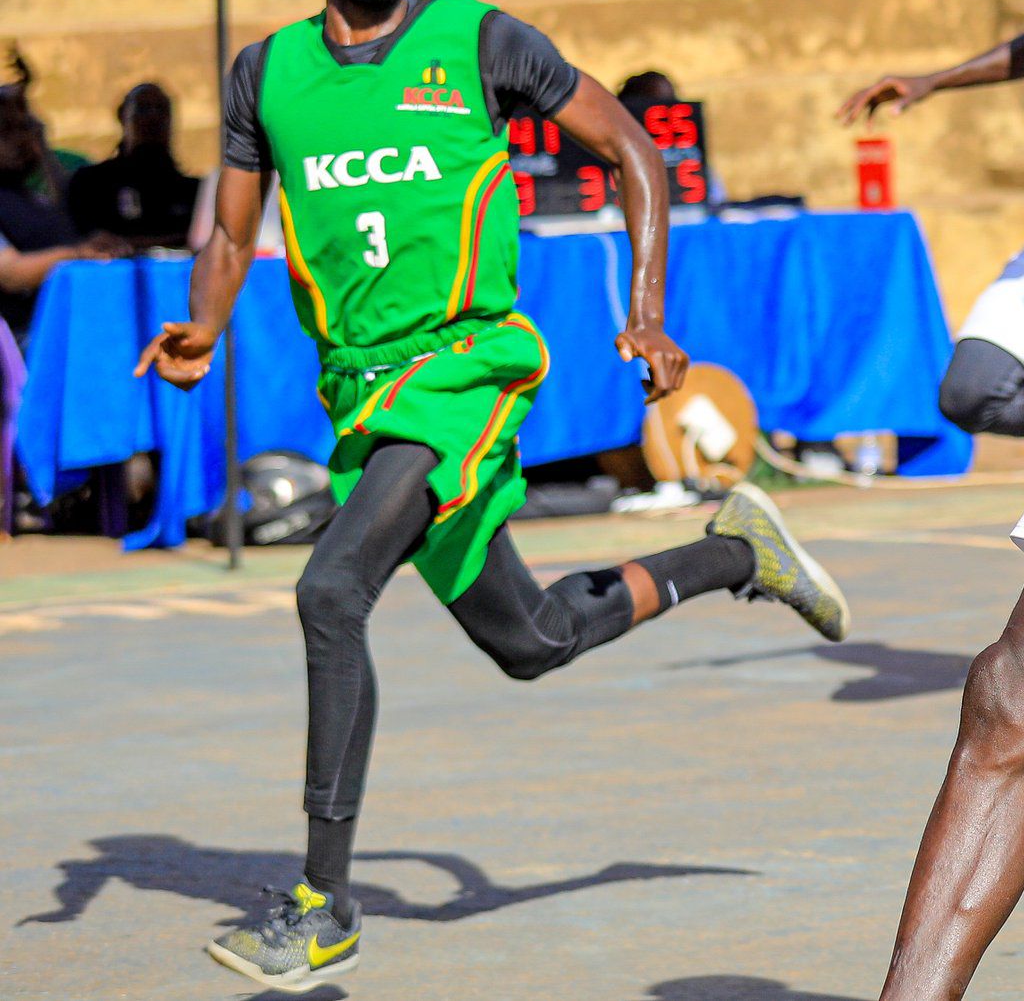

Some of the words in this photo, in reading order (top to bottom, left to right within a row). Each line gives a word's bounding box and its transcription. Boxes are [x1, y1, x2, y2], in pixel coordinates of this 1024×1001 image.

[403, 87, 464, 108] KCCA
[644, 103, 698, 150] 55
[303, 145, 443, 192] KCCA
[676, 159, 706, 204] 5
[355, 211, 390, 268] 3
